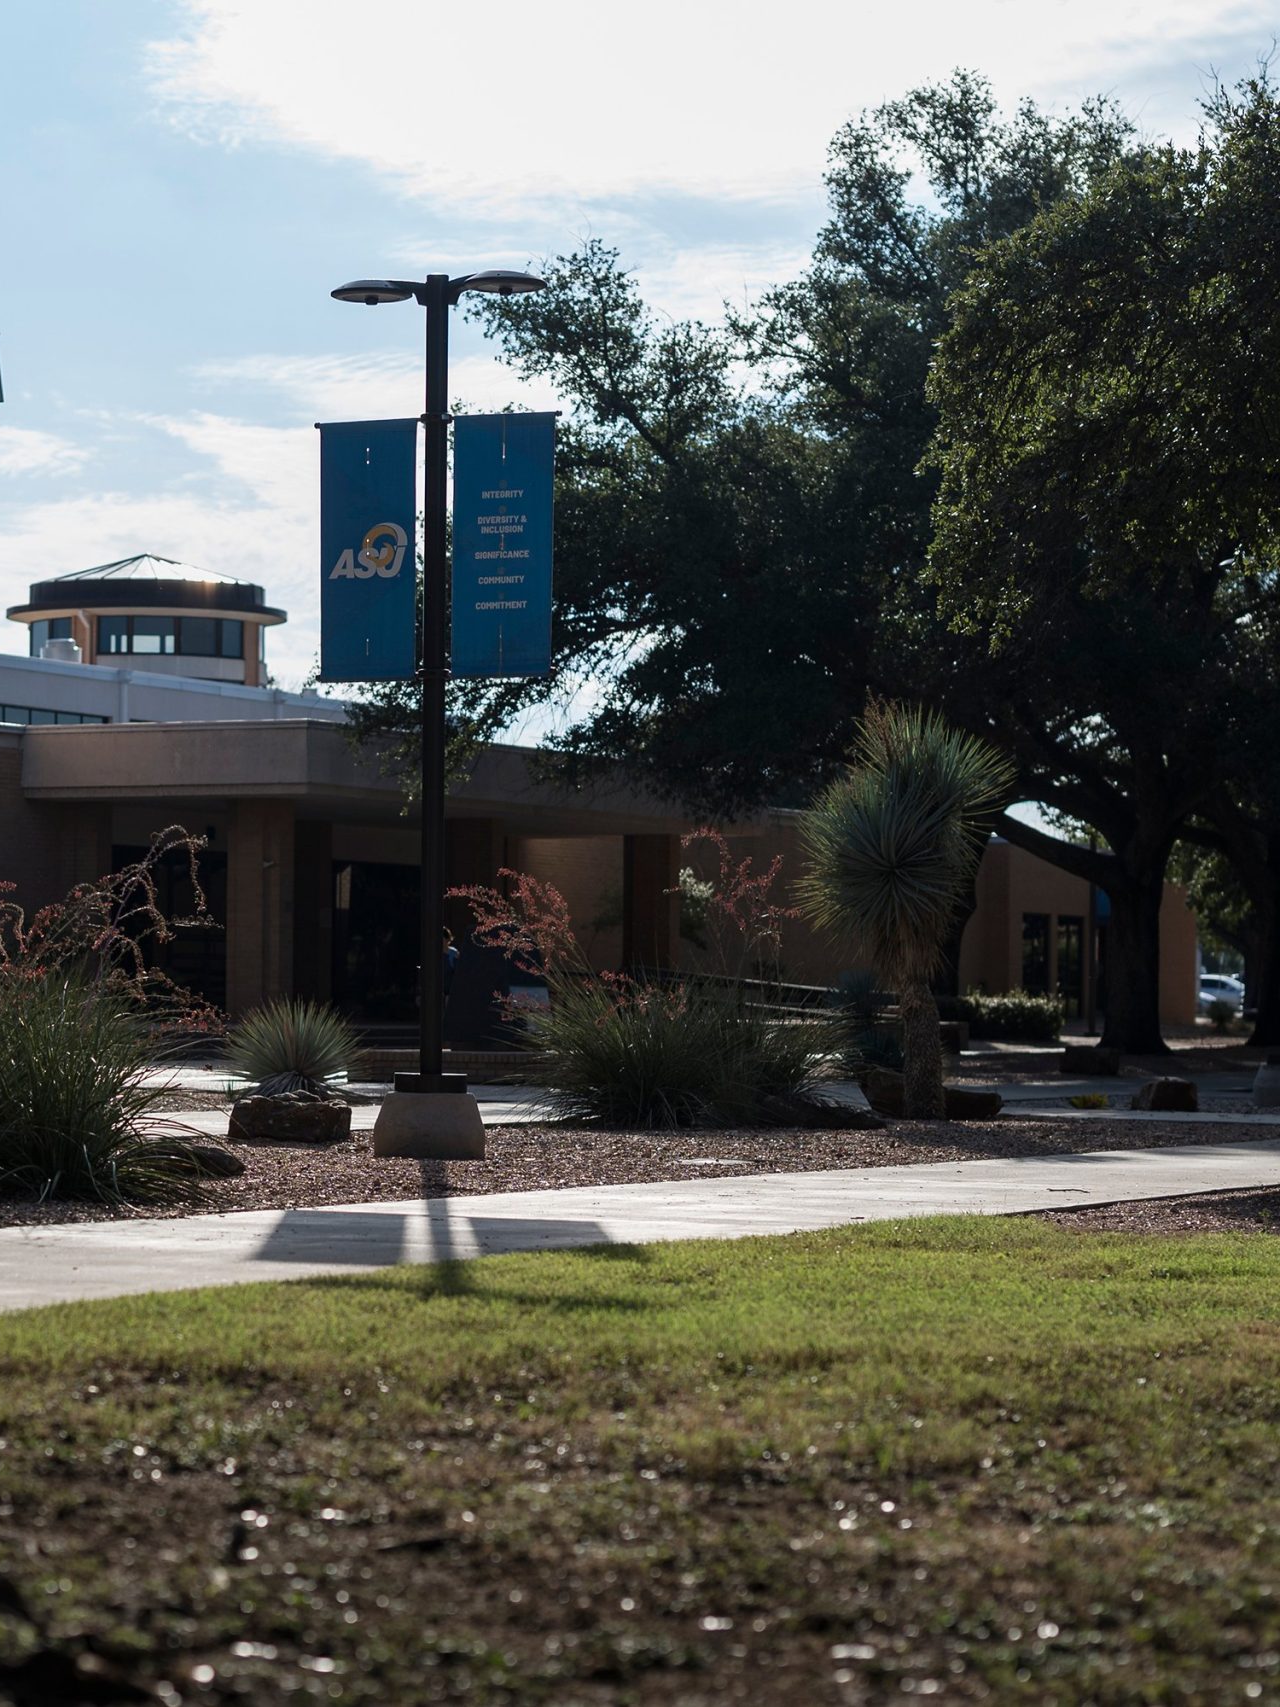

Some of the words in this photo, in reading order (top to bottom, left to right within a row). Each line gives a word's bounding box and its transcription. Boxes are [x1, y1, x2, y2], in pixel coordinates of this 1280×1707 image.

[481, 489, 524, 499] INTEGRITY
[477, 515, 519, 525] DIVERSITY
[520, 514, 528, 523] &
[480, 525, 524, 534] INCLUSION
[474, 550, 530, 560] SIGNIFICANCE
[477, 575, 525, 585] COMMUNITY
[475, 600, 528, 610] COMMITMENT
